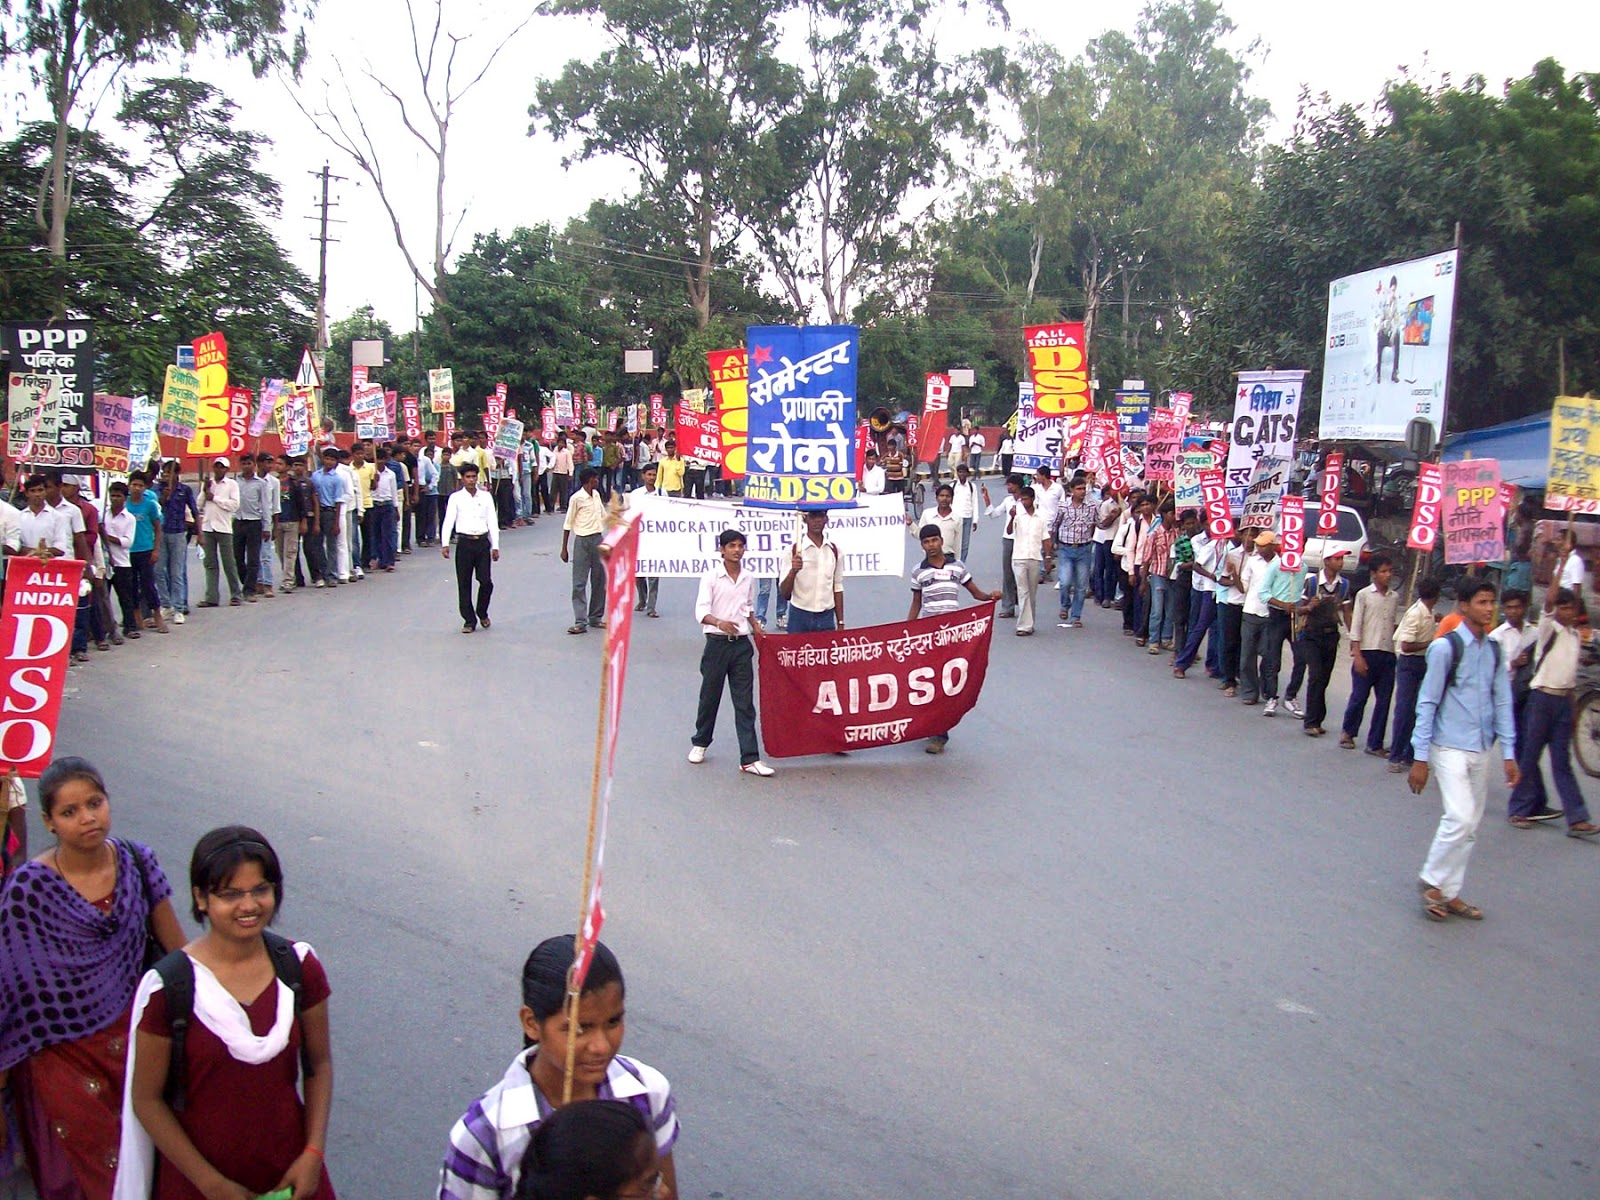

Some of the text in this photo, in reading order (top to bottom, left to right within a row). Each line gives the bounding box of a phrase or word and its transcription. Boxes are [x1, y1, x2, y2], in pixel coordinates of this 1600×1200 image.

[18, 329, 87, 349] PPP
[199, 339, 216, 354] ALL
[1027, 337, 1078, 348] INDIA
[1034, 329, 1066, 339] ALL
[196, 350, 225, 367] INDIA
[749, 340, 851, 406] सेमेस्टर
[1029, 346, 1089, 414] DSO
[489, 406, 499, 433] DSO
[652, 402, 662, 424] DSO
[779, 390, 852, 424] प्रणाली
[230, 402, 249, 452] DSO
[406, 408, 420, 438] DSO
[908, 424, 918, 446] DSO
[752, 422, 850, 474] रोको
[1086, 436, 1105, 470] DSO
[748, 474, 775, 487] ALL
[1105, 454, 1126, 491] DSO
[744, 486, 780, 500] INDIA
[778, 476, 854, 502] DSO
[1319, 473, 1339, 529] DSO
[1457, 486, 1497, 507] PPP
[1203, 485, 1232, 535] DSO
[1411, 483, 1441, 544] DSO
[1564, 496, 1597, 512] DSO
[1247, 516, 1273, 527] DSO
[1281, 514, 1304, 568] DSO
[26, 572, 69, 587] ALL
[14, 592, 75, 607] INDIA
[0, 613, 70, 763] DSO
[812, 657, 969, 716] AIDSO
[844, 717, 914, 743] जमालपुर
